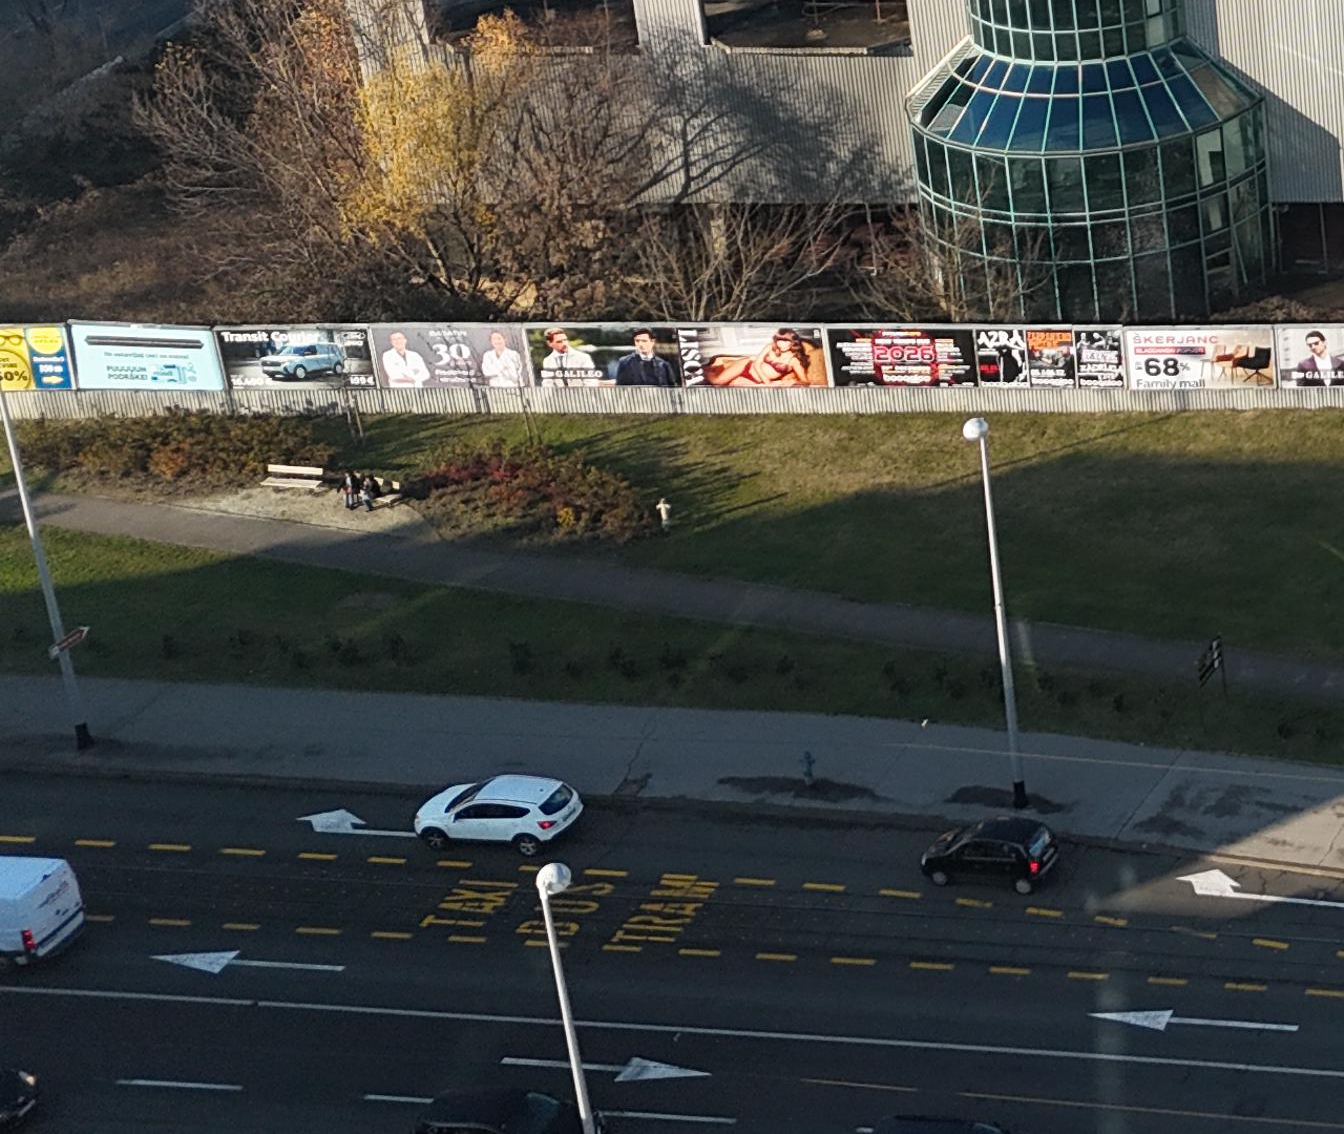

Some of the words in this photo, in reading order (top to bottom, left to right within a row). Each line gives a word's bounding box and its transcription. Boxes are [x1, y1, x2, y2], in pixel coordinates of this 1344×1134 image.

[220, 331, 269, 342] Transit
[271, 331, 321, 343] Courier
[1133, 333, 1219, 344] ŠKERJANC
[432, 343, 471, 366] 30
[873, 345, 935, 363] 2026
[555, 369, 603, 378] GALILEO
[1136, 378, 1178, 390] Family
[1179, 378, 1206, 388] mall
[419, 879, 519, 928] TAXI
[515, 881, 616, 937] BUS
[610, 873, 720, 943] TRAM
